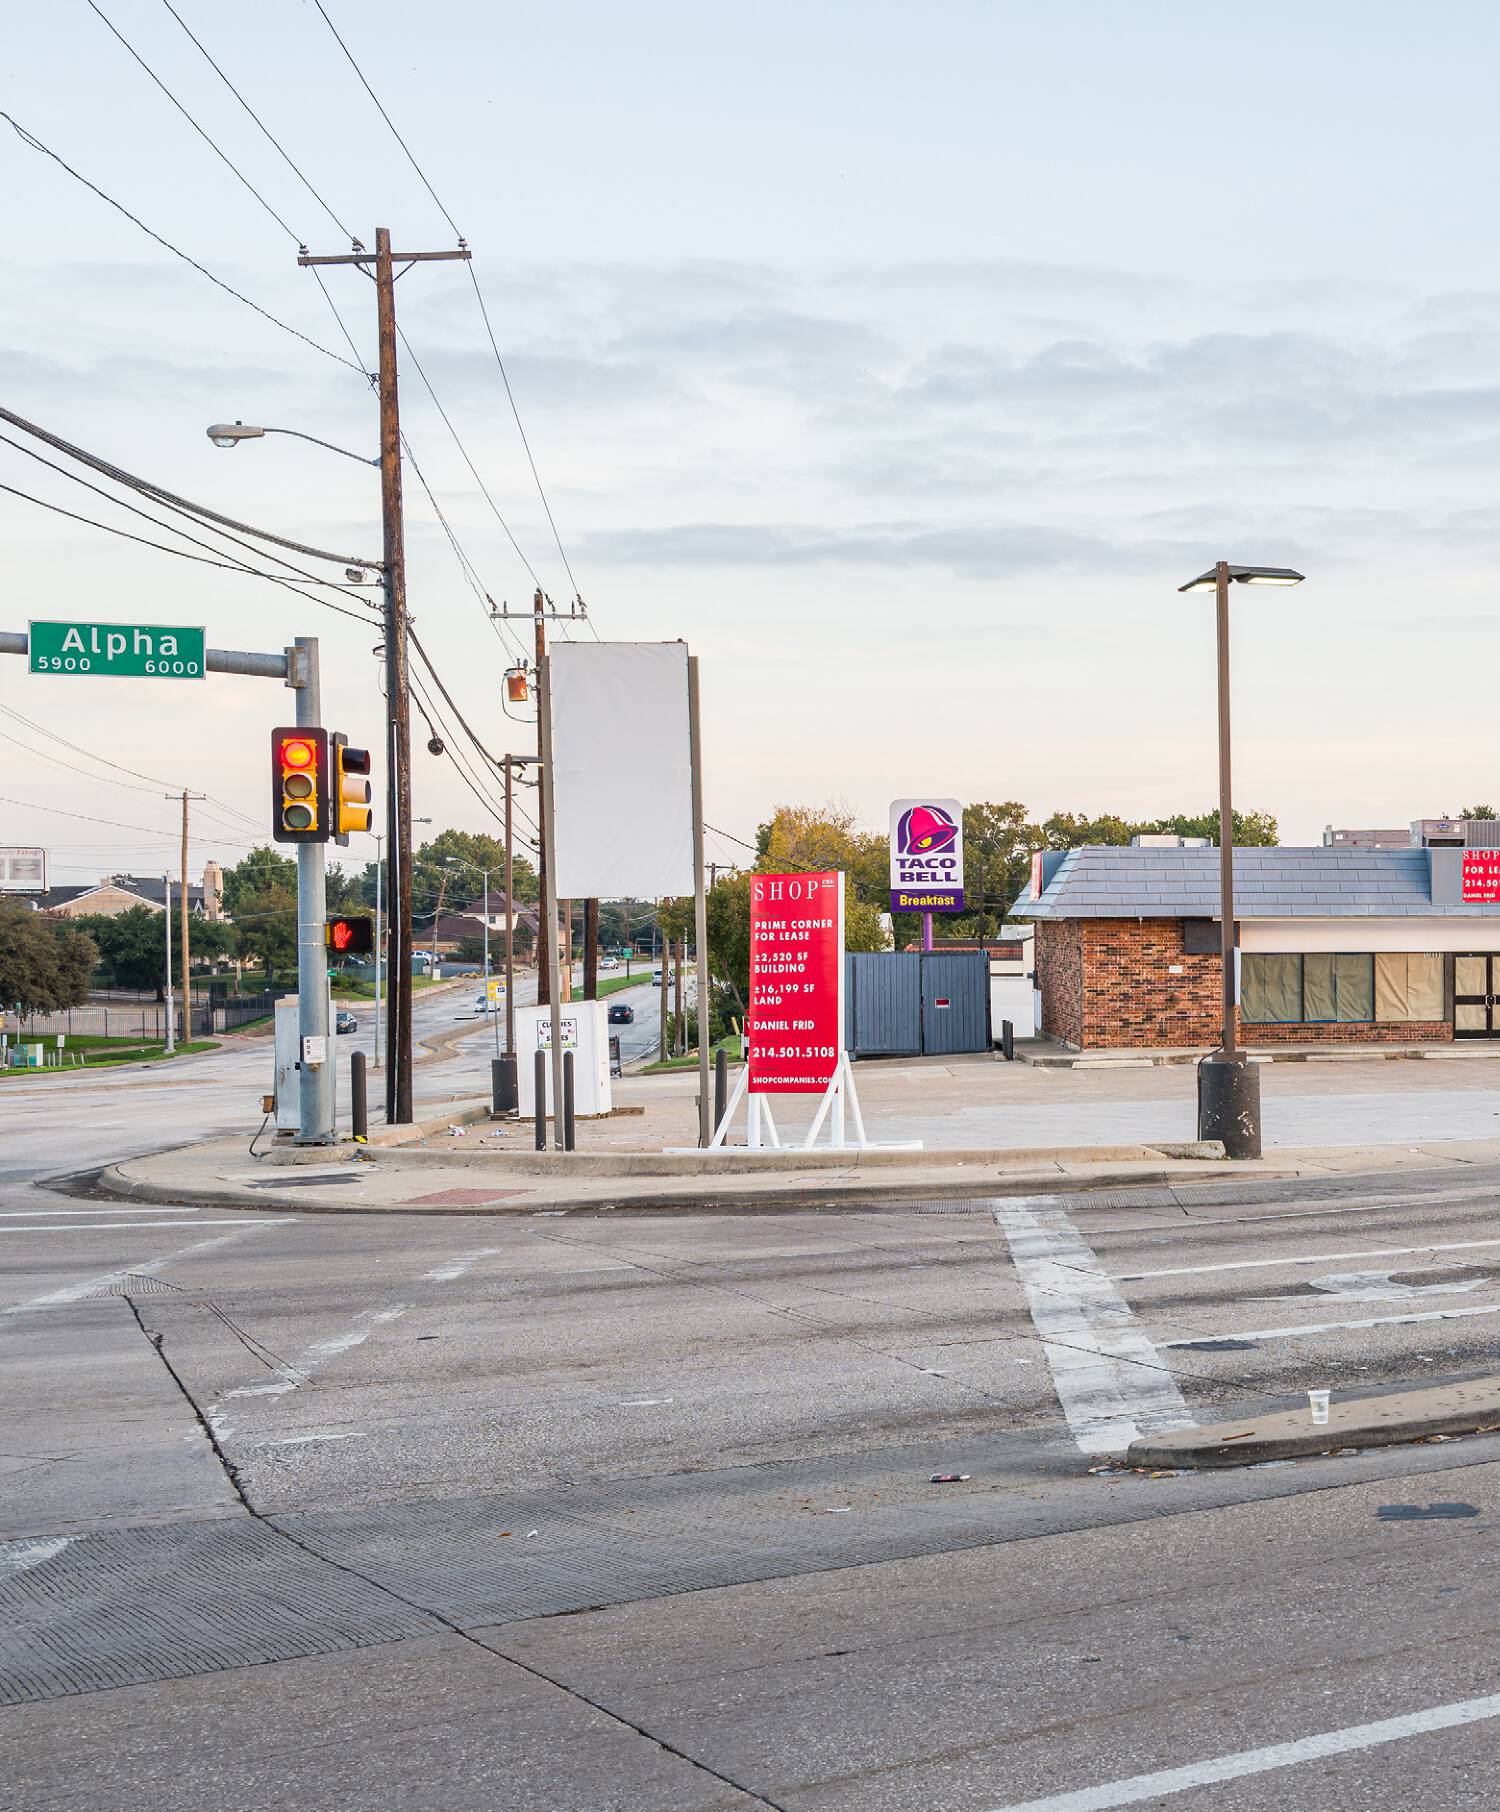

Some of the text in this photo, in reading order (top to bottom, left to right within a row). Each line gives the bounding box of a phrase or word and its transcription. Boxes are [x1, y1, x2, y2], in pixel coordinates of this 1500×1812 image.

[60, 627, 178, 661] Alpha
[38, 656, 199, 675] 5900 6000
[895, 858, 957, 869] TACO
[1465, 866, 1484, 874] FOR
[900, 872, 958, 882] BELL
[754, 880, 818, 901] SHOP
[900, 894, 955, 906] Breakfast
[755, 919, 833, 930] PRIME CORNER
[755, 931, 810, 941] FOR LEASE
[797, 952, 808, 960] SF
[754, 964, 805, 973] BUILDING
[803, 984, 815, 993] SF
[753, 996, 782, 1005] LAND
[753, 1020, 815, 1030] DANIEL FRID
[752, 1047, 835, 1058] 214.501.5108
